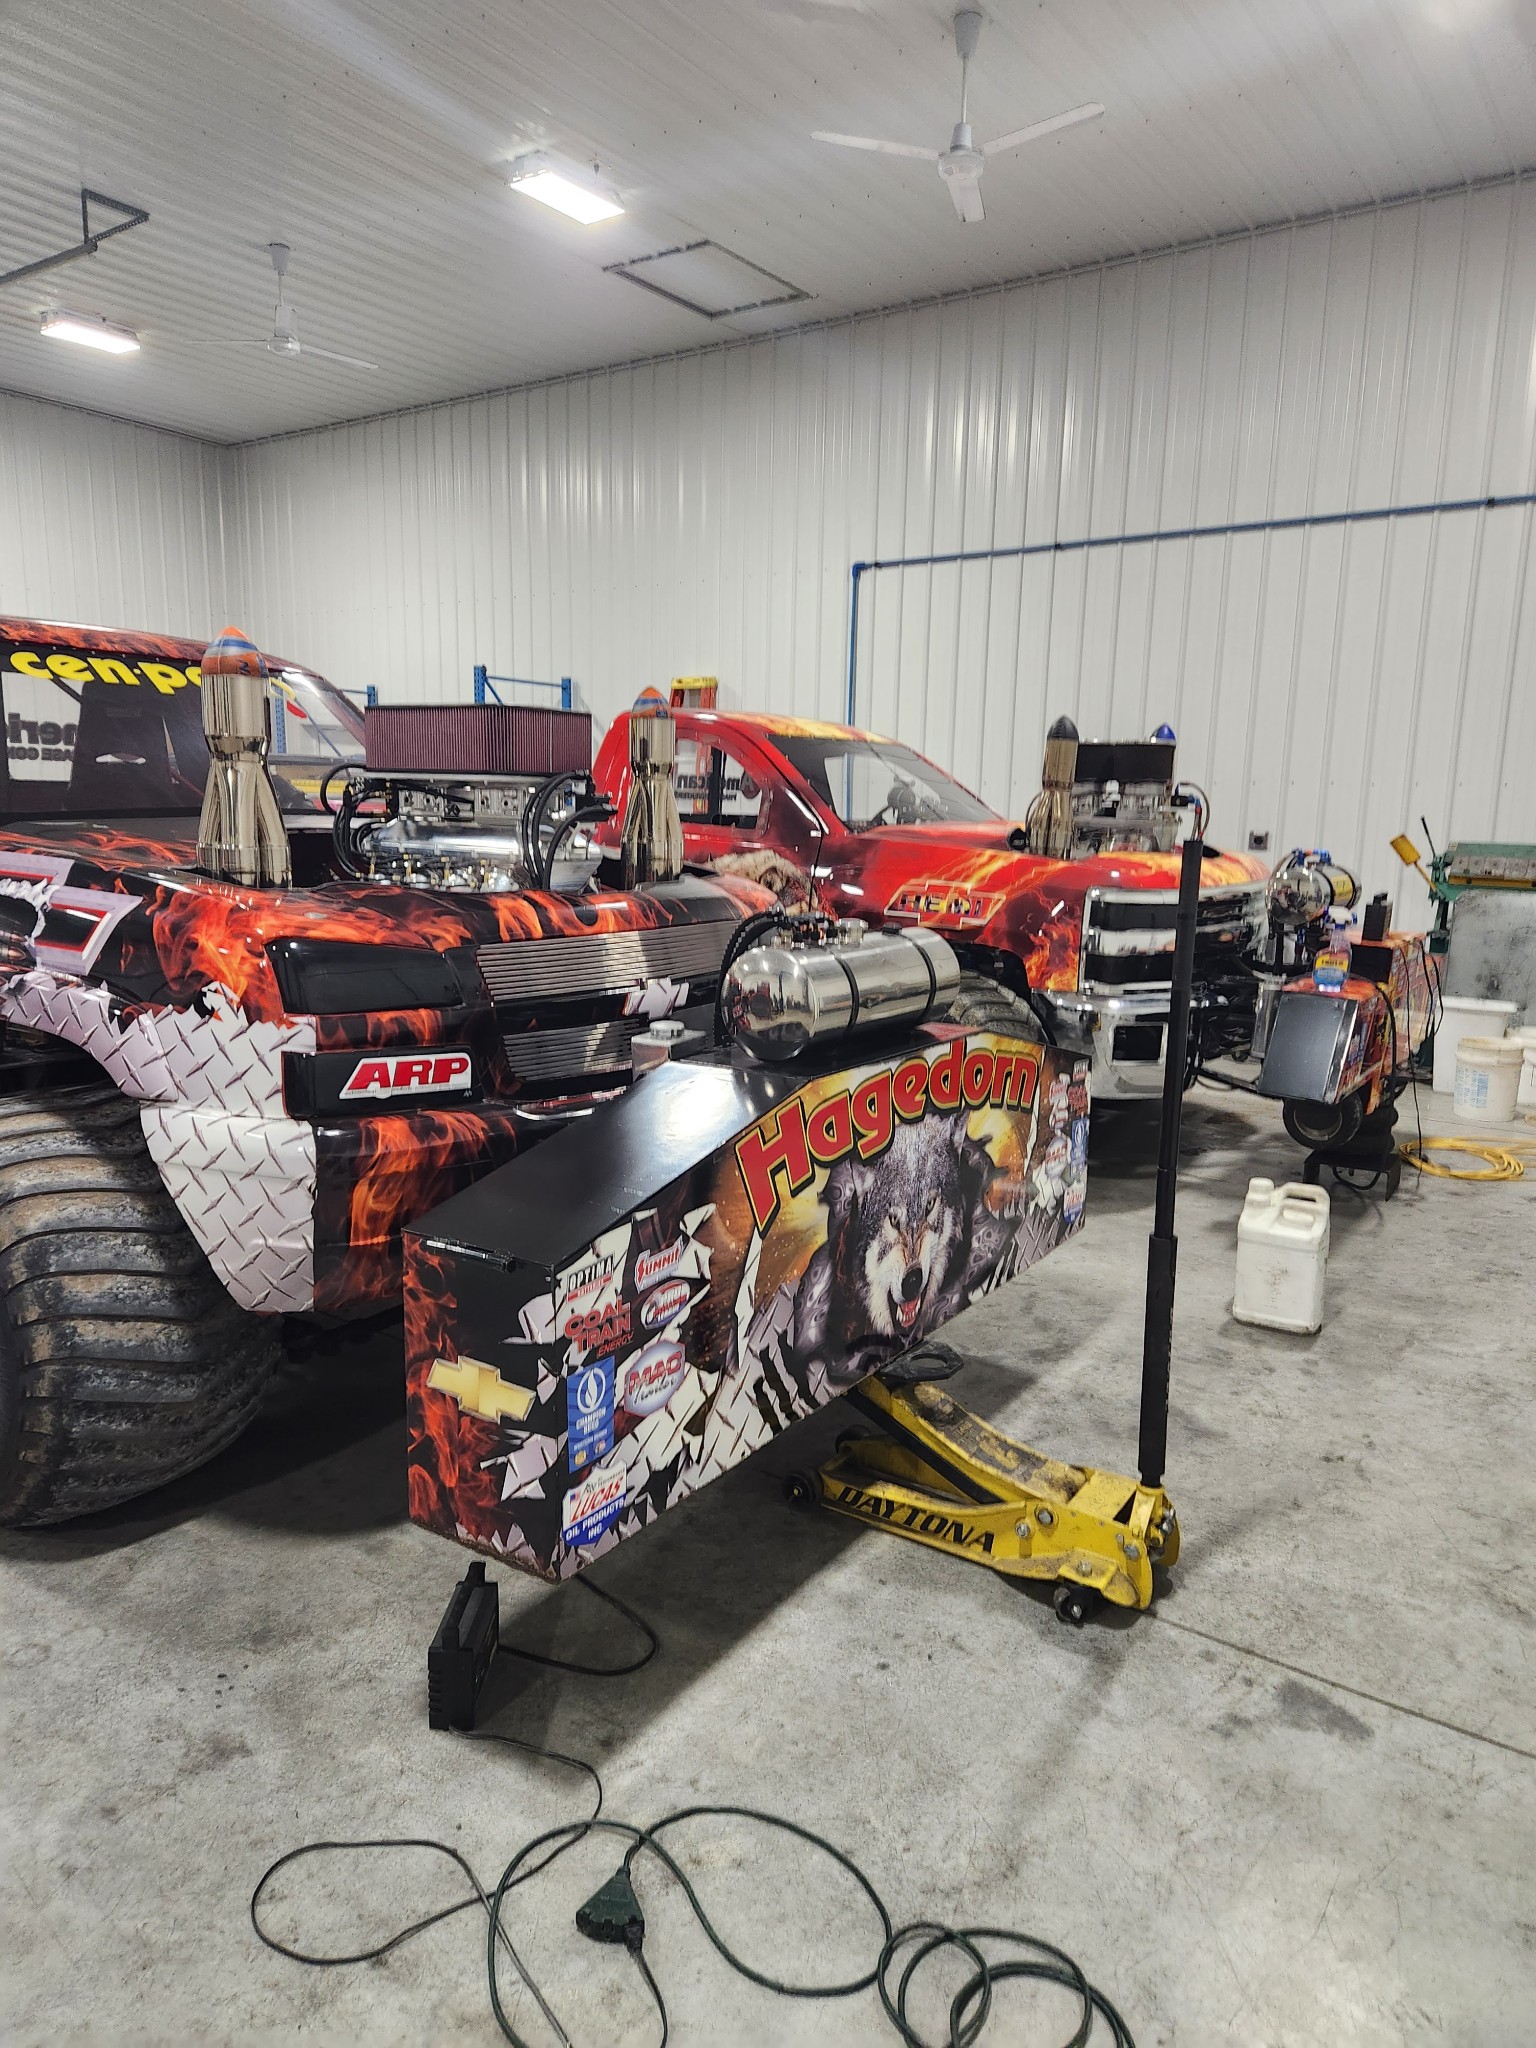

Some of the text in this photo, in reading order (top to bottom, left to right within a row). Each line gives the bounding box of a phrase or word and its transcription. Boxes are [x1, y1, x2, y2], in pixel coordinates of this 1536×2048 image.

[347, 1058, 469, 1090] ARP
[735, 1037, 1038, 1231] Hagedorn
[568, 1254, 615, 1293] OPTIMA
[565, 1297, 631, 1338] COAL
[573, 1310, 632, 1354] TRAIN
[597, 1328, 634, 1358] ENERGY
[628, 1351, 683, 1396] MAC
[565, 1496, 625, 1541] OIL PRODUCTS
[570, 1475, 624, 1523] LUCAS
[836, 1486, 995, 1554] DAYTONA
